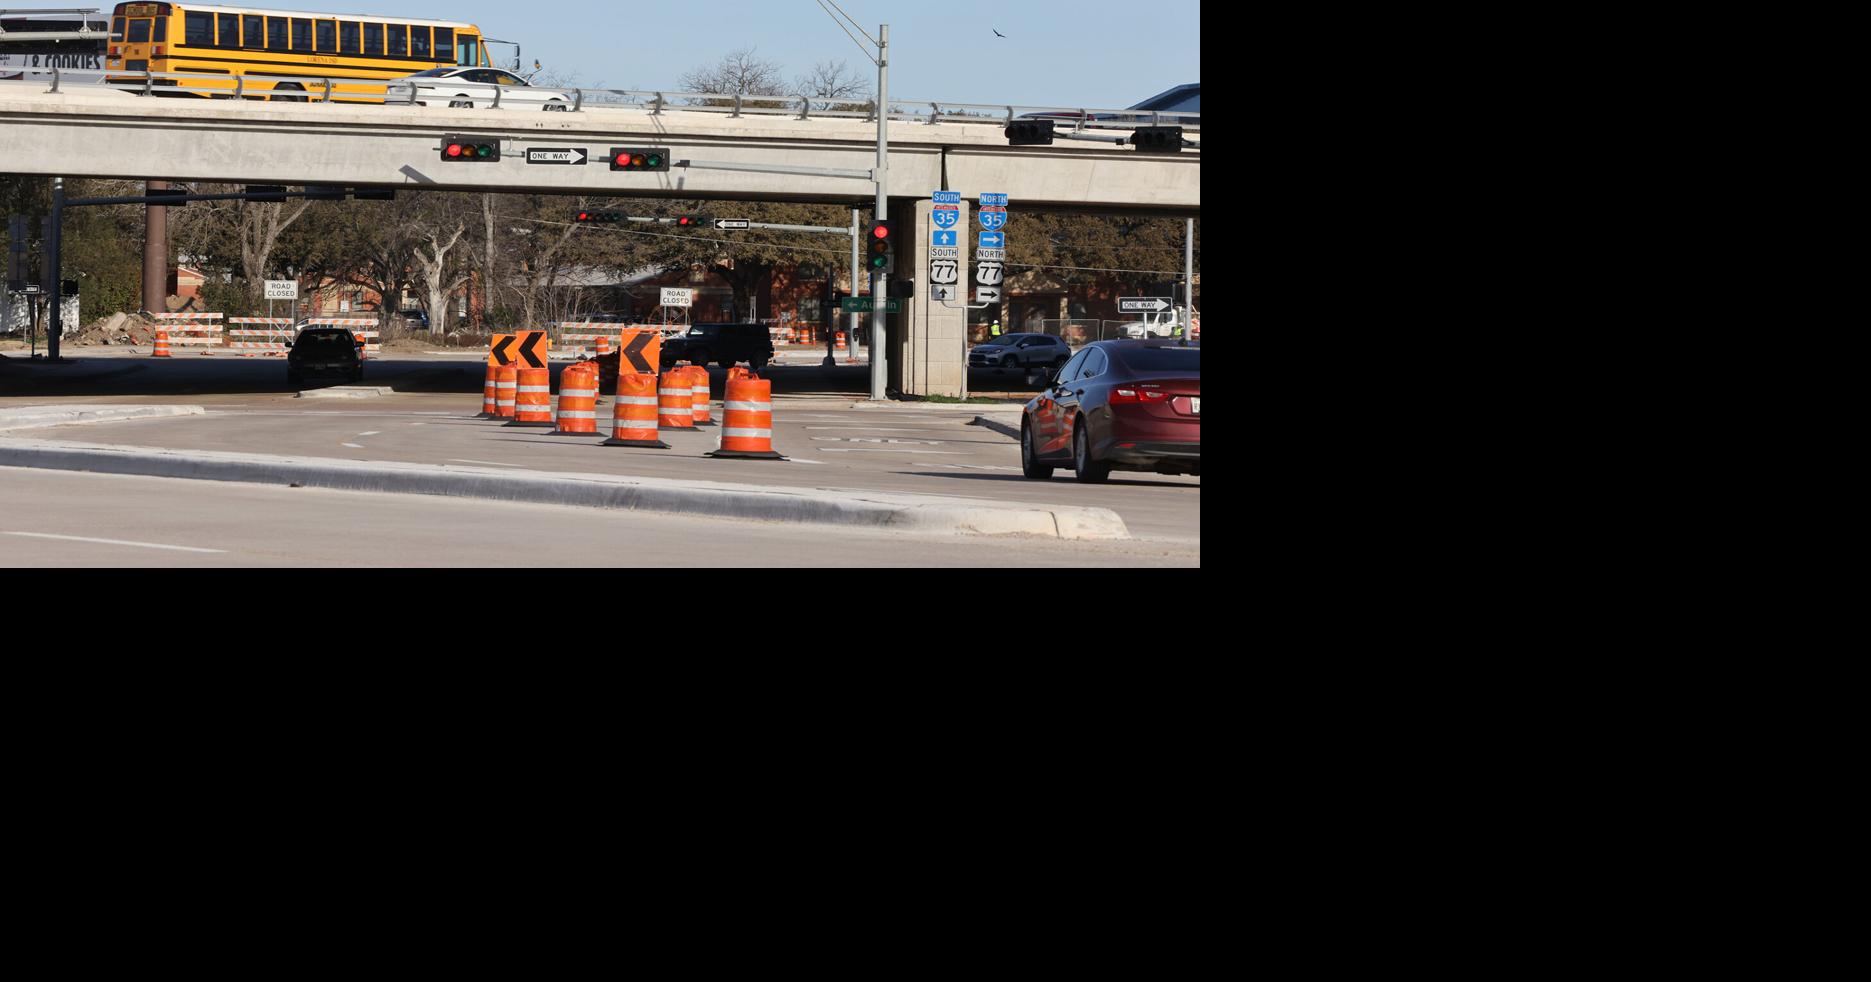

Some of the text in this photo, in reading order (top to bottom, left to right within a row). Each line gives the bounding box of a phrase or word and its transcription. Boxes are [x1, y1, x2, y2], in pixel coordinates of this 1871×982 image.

[45, 54, 100, 73] COOKIES
[934, 193, 960, 202] SOUTH
[981, 195, 1006, 204] NORTH
[936, 213, 955, 225] 35
[983, 214, 1002, 227] 35
[932, 248, 957, 256] SOUTH
[978, 250, 1004, 258] NORTH
[933, 264, 955, 279] 77
[980, 266, 1001, 280] 77
[861, 301, 897, 309] Auin
